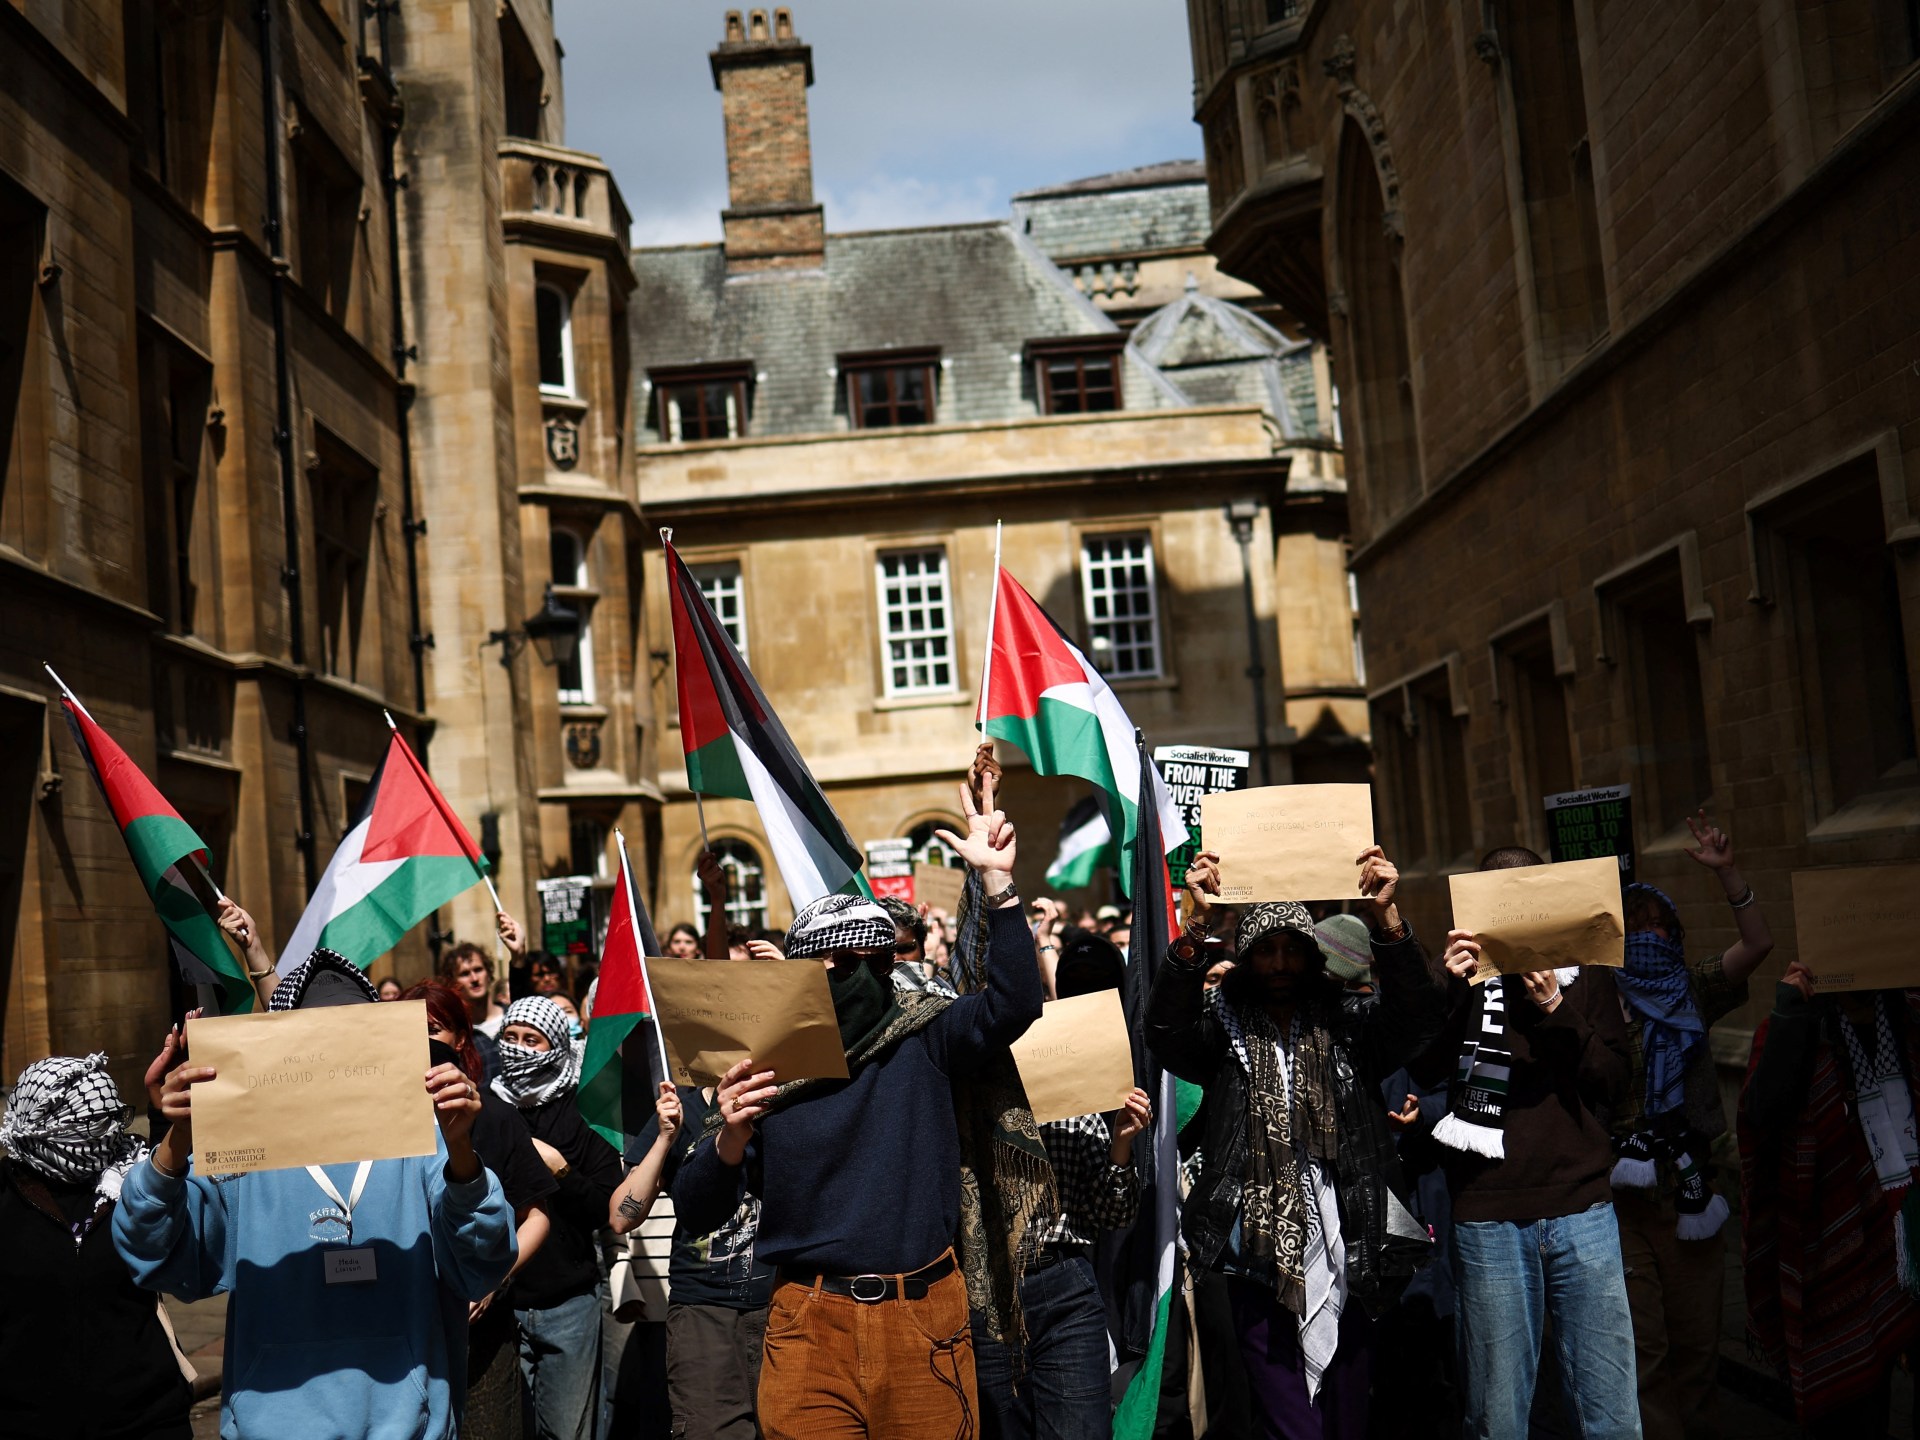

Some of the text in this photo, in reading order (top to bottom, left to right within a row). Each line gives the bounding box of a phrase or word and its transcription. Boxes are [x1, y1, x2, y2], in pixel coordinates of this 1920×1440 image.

[1170, 750, 1237, 764] Socialist Worker
[1164, 763, 1237, 788] FROM THE
[1556, 789, 1621, 806] Socialist Worker
[1555, 801, 1624, 826] FROM THE
[1217, 824, 1248, 838] ANNE
[1557, 820, 1619, 843] RIVER TO
[1559, 839, 1616, 861] THE SEA
[1492, 912, 1550, 927] BHASKAR VIRA
[719, 1011, 761, 1023] PRENTICE
[283, 1055, 301, 1065] PRO
[248, 1070, 314, 1089] DIARMUID
[1465, 1088, 1489, 1103] FREE
[218, 1148, 257, 1157] UNIVERSITY
[218, 1153, 267, 1164] CAMBRIDGE
[338, 1258, 359, 1266] Media
